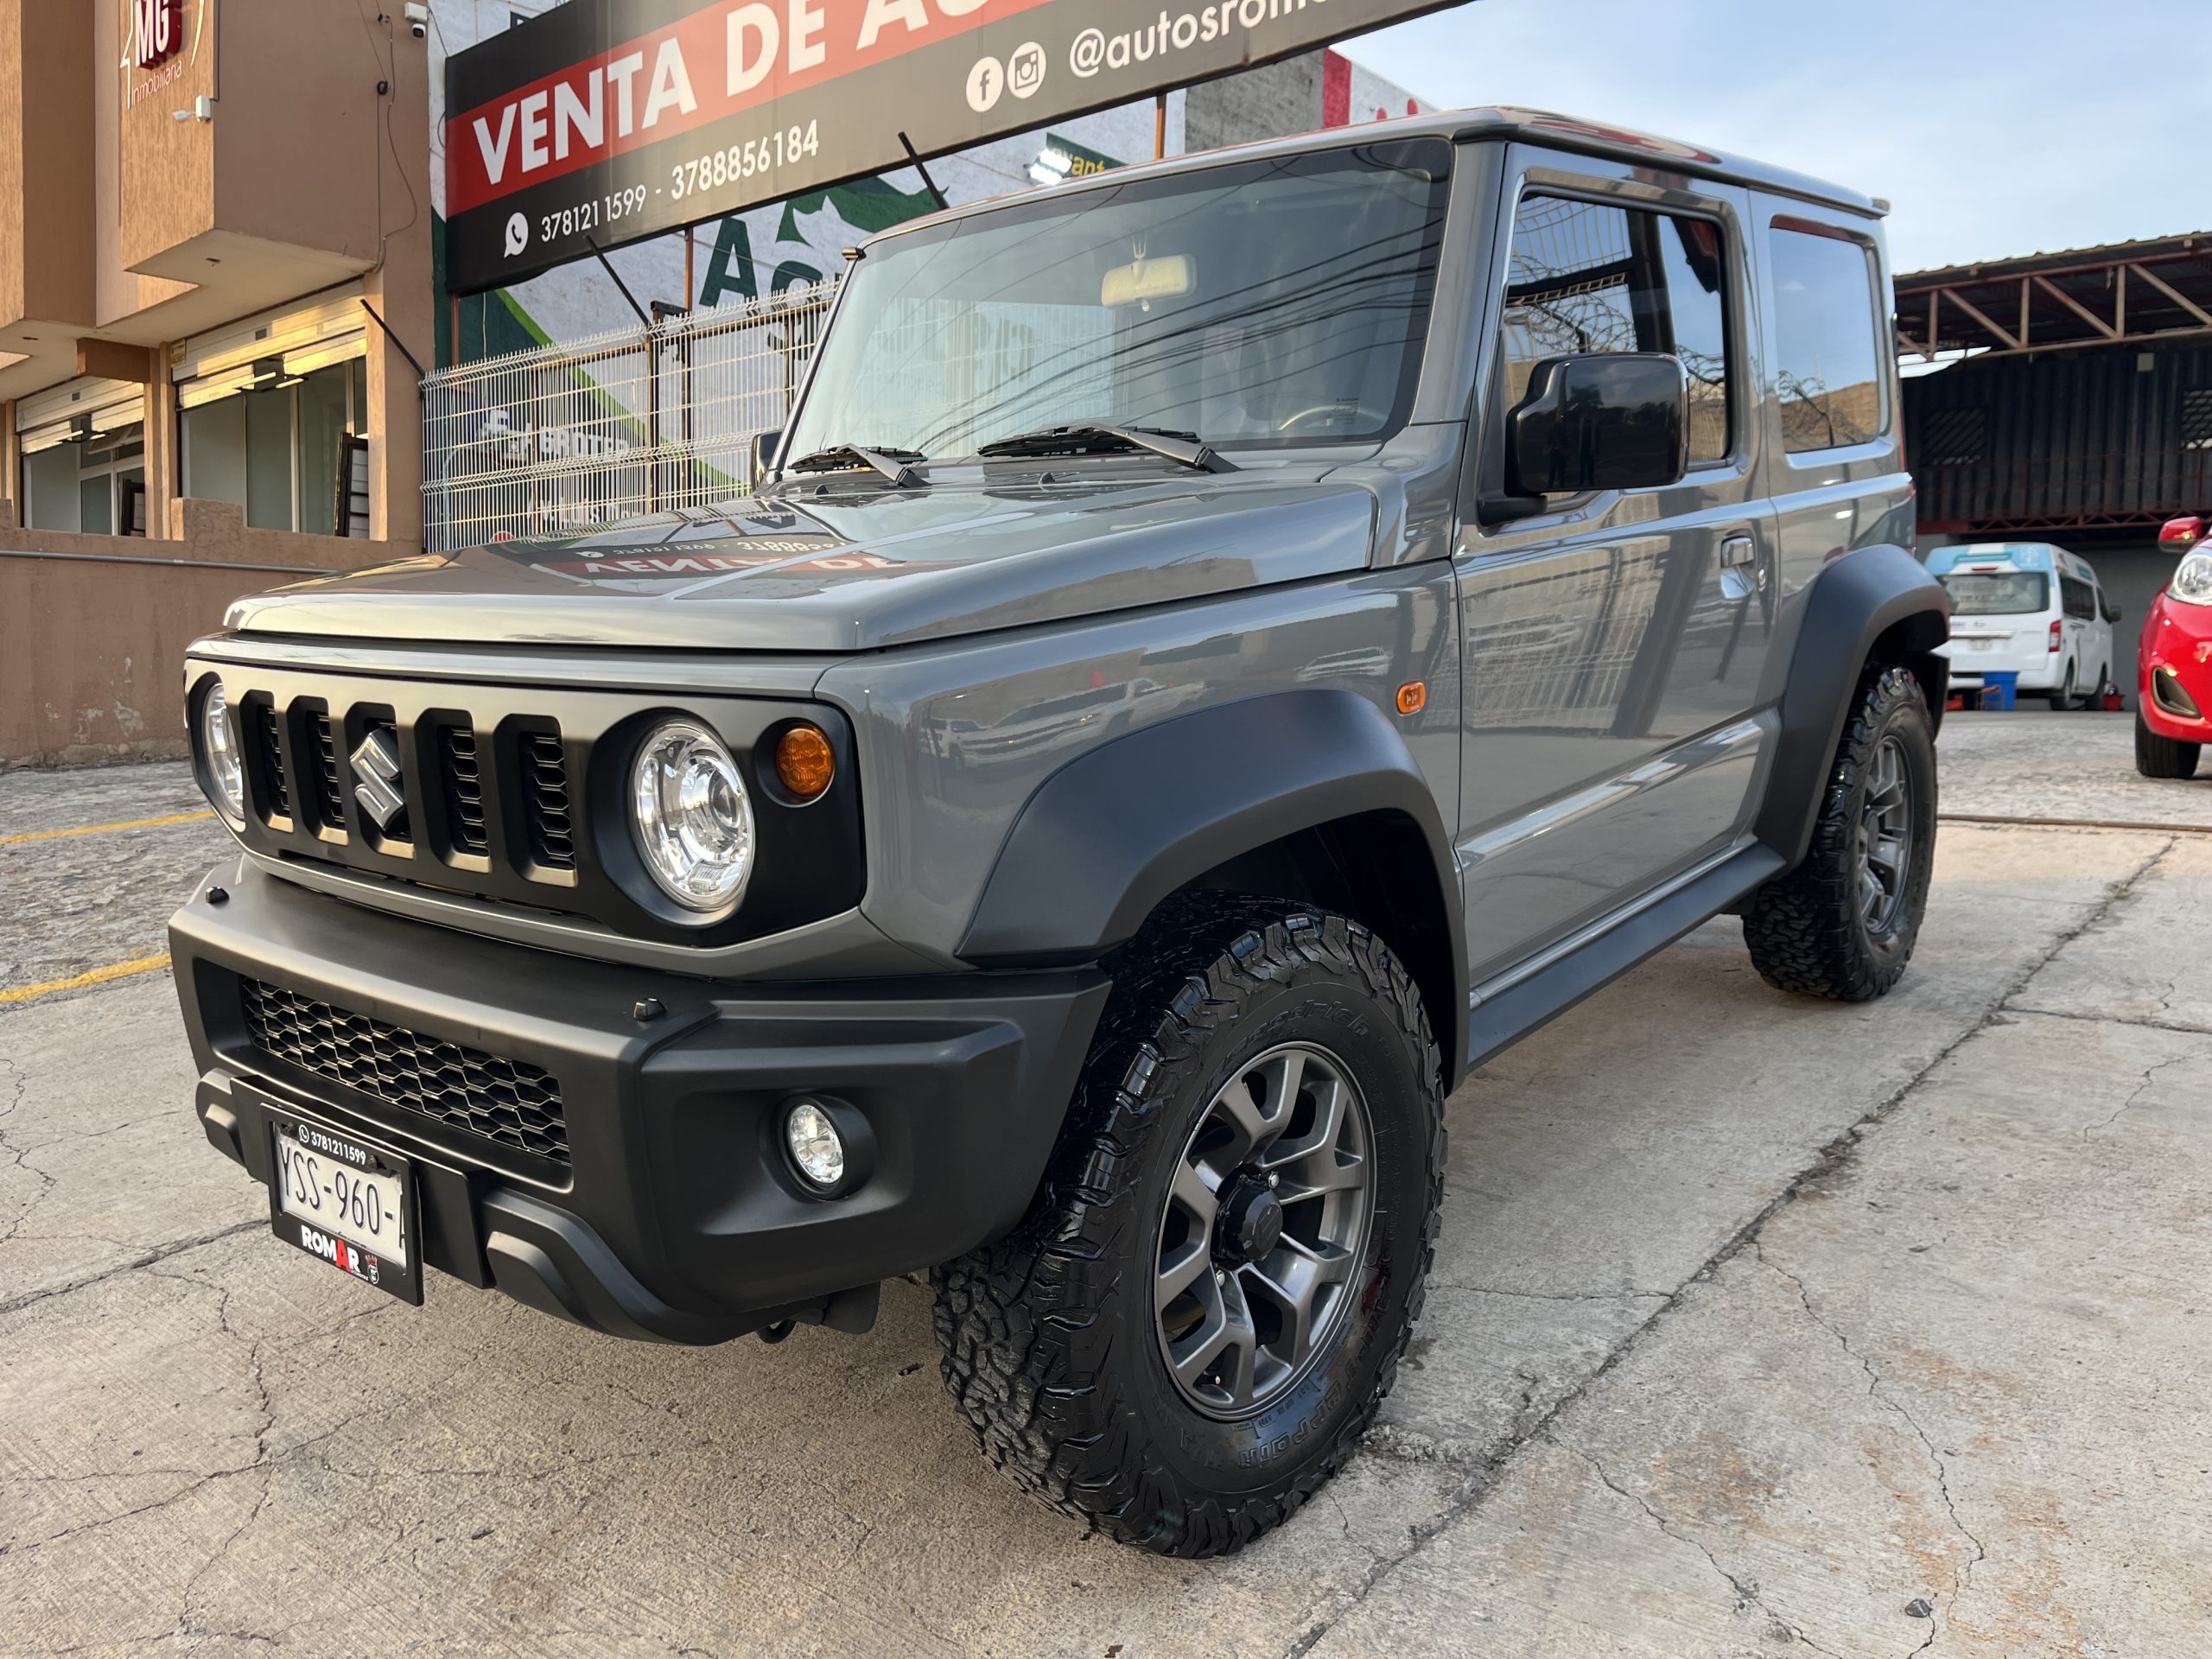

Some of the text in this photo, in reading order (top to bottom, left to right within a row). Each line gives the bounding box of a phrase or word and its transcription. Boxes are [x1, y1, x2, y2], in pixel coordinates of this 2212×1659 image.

[135, 0, 169, 67] MG
[1069, 0, 1327, 78] @autosro
[473, 36, 697, 186] VENTA
[727, 0, 826, 98] DE
[541, 184, 646, 242] 3781211599
[671, 118, 819, 200] 3788856184
[311, 1131, 366, 1166] 3781211599
[279, 1141, 404, 1249] YSS-960-
[302, 1224, 360, 1273] ROMAR
